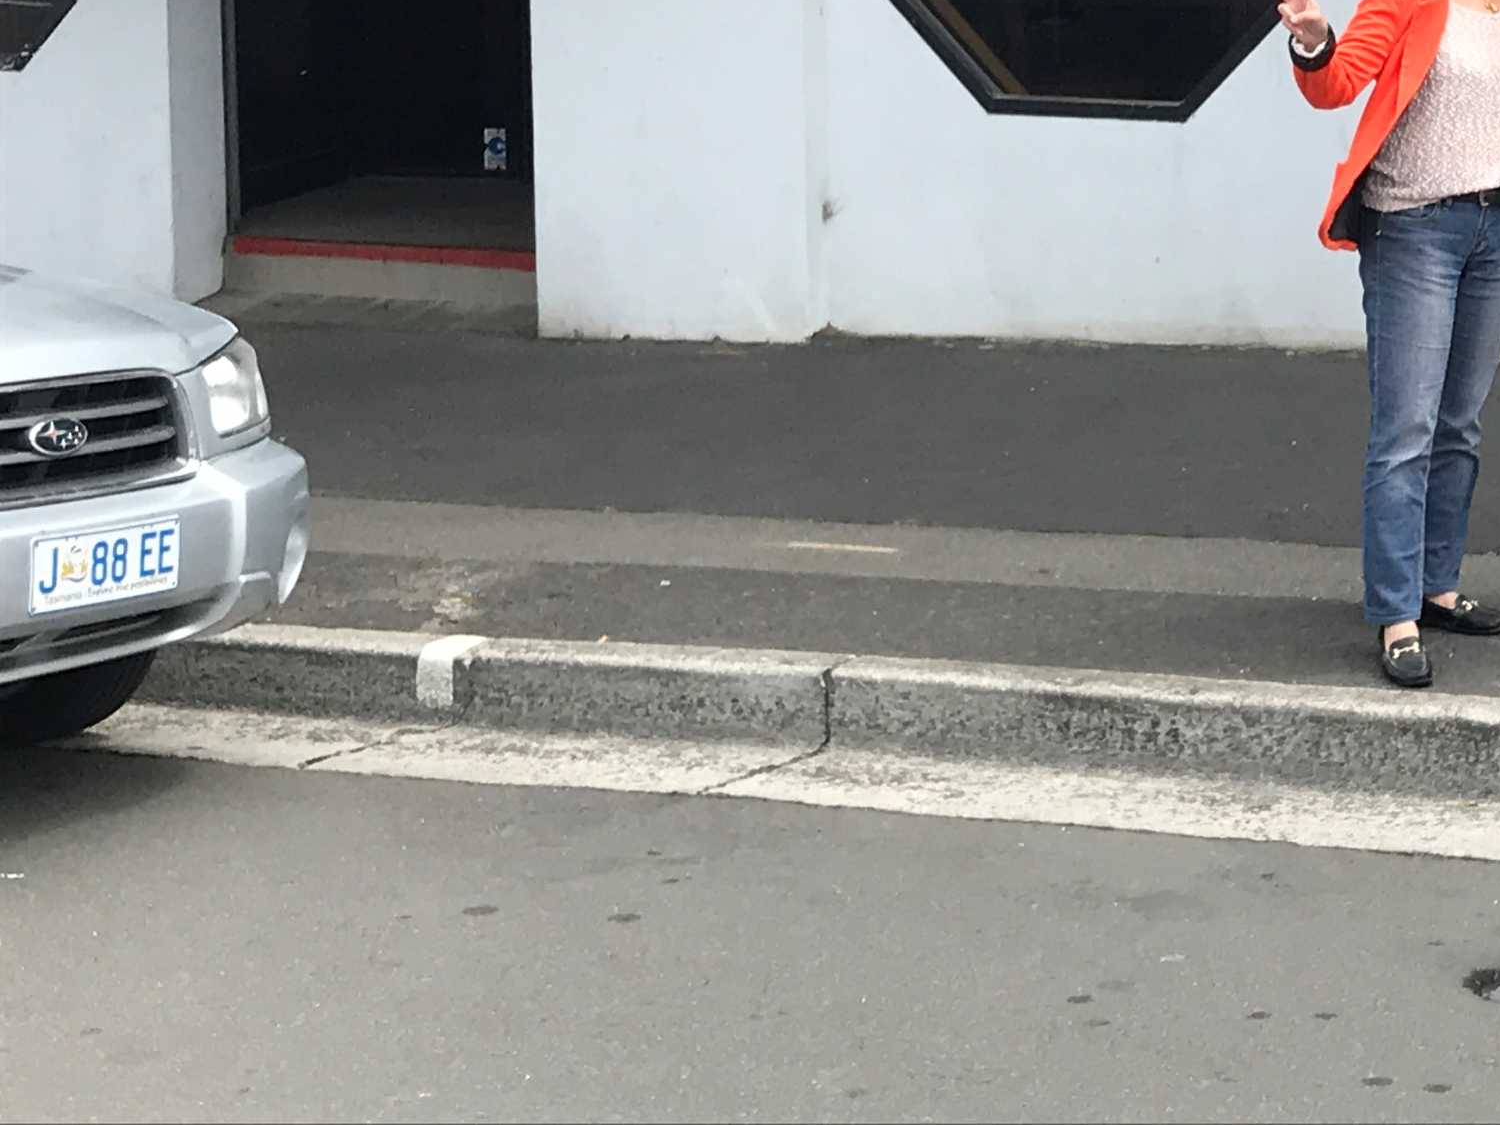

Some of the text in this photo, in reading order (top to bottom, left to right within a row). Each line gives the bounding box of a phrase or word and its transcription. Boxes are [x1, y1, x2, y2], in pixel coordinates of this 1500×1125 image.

[39, 528, 175, 594] J 88 EE
